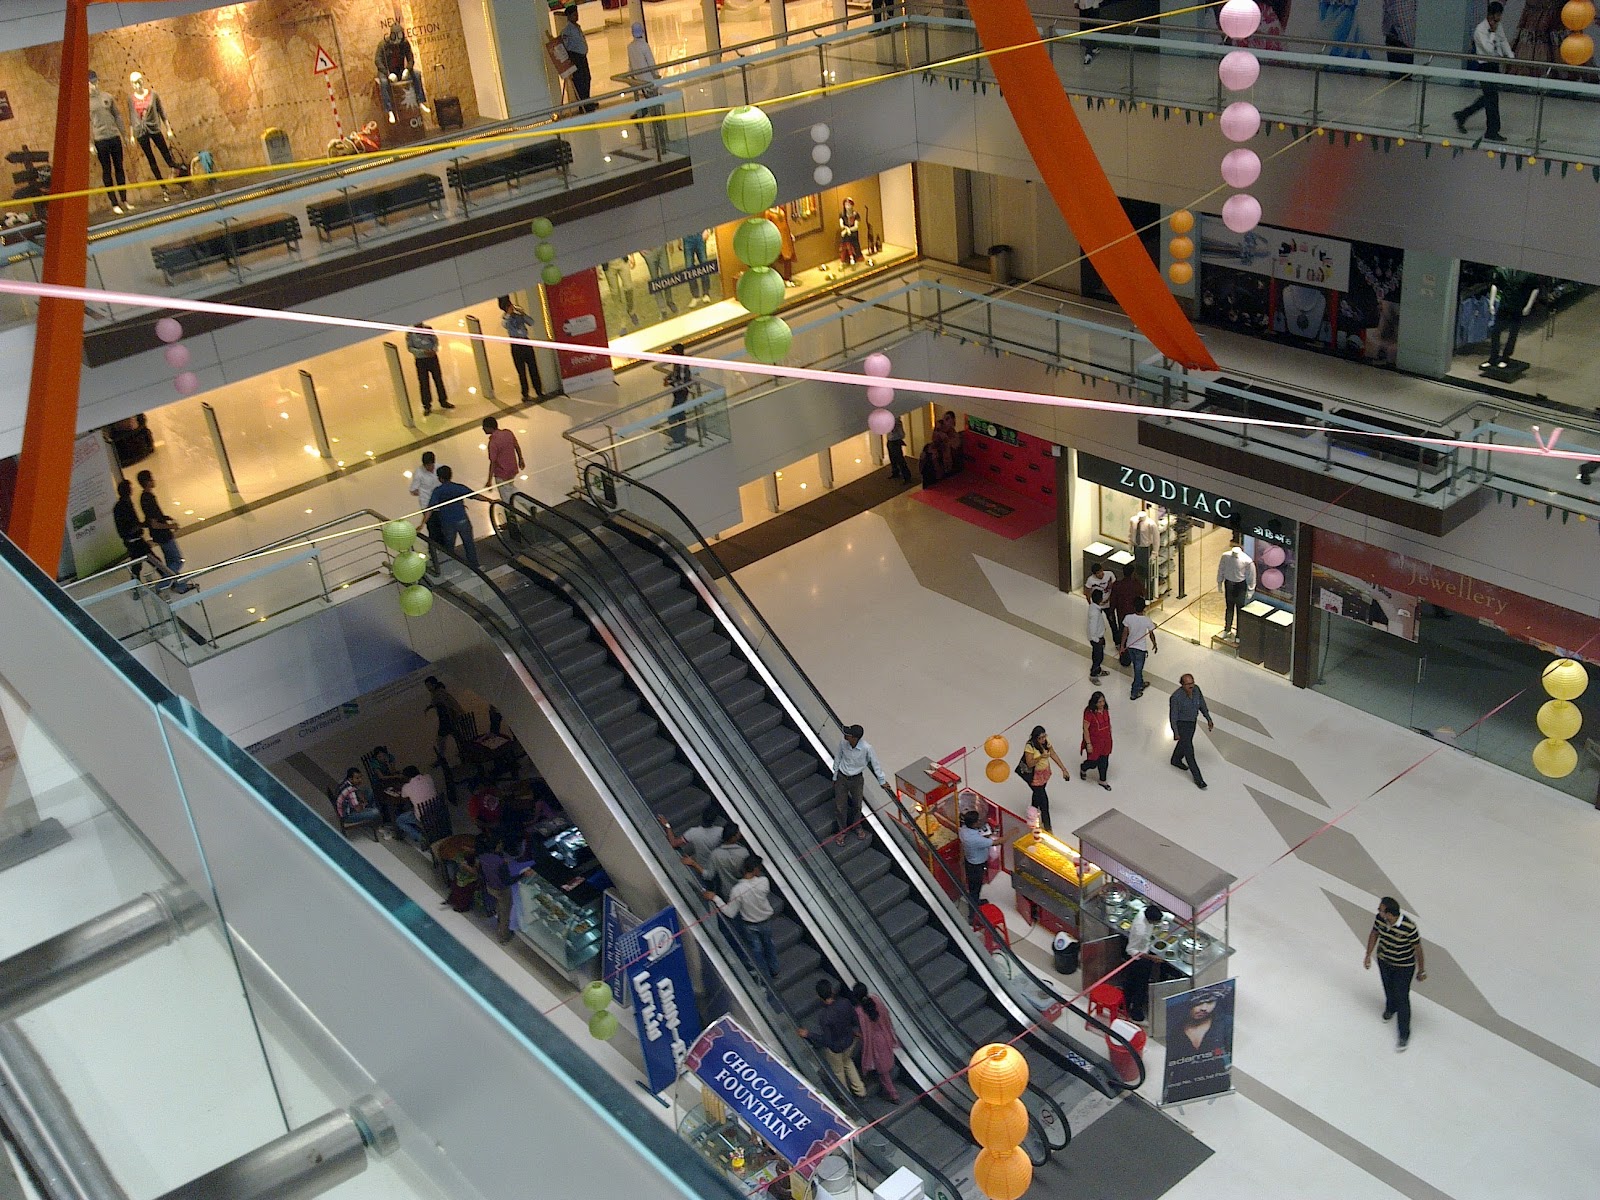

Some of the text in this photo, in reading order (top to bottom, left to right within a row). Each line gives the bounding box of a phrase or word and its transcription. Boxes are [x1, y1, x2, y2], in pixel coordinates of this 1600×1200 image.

[380, 16, 401, 29] NEW
[383, 22, 440, 42] COLECTION
[650, 263, 716, 291] INDIAN TERRAIN
[1120, 466, 1232, 519] ZODIAC
[1407, 567, 1509, 615] Jewellery
[1168, 1051, 1213, 1067] adams
[714, 1068, 793, 1141] FOUNTAIN
[722, 1050, 812, 1131] CHOCOLATE
